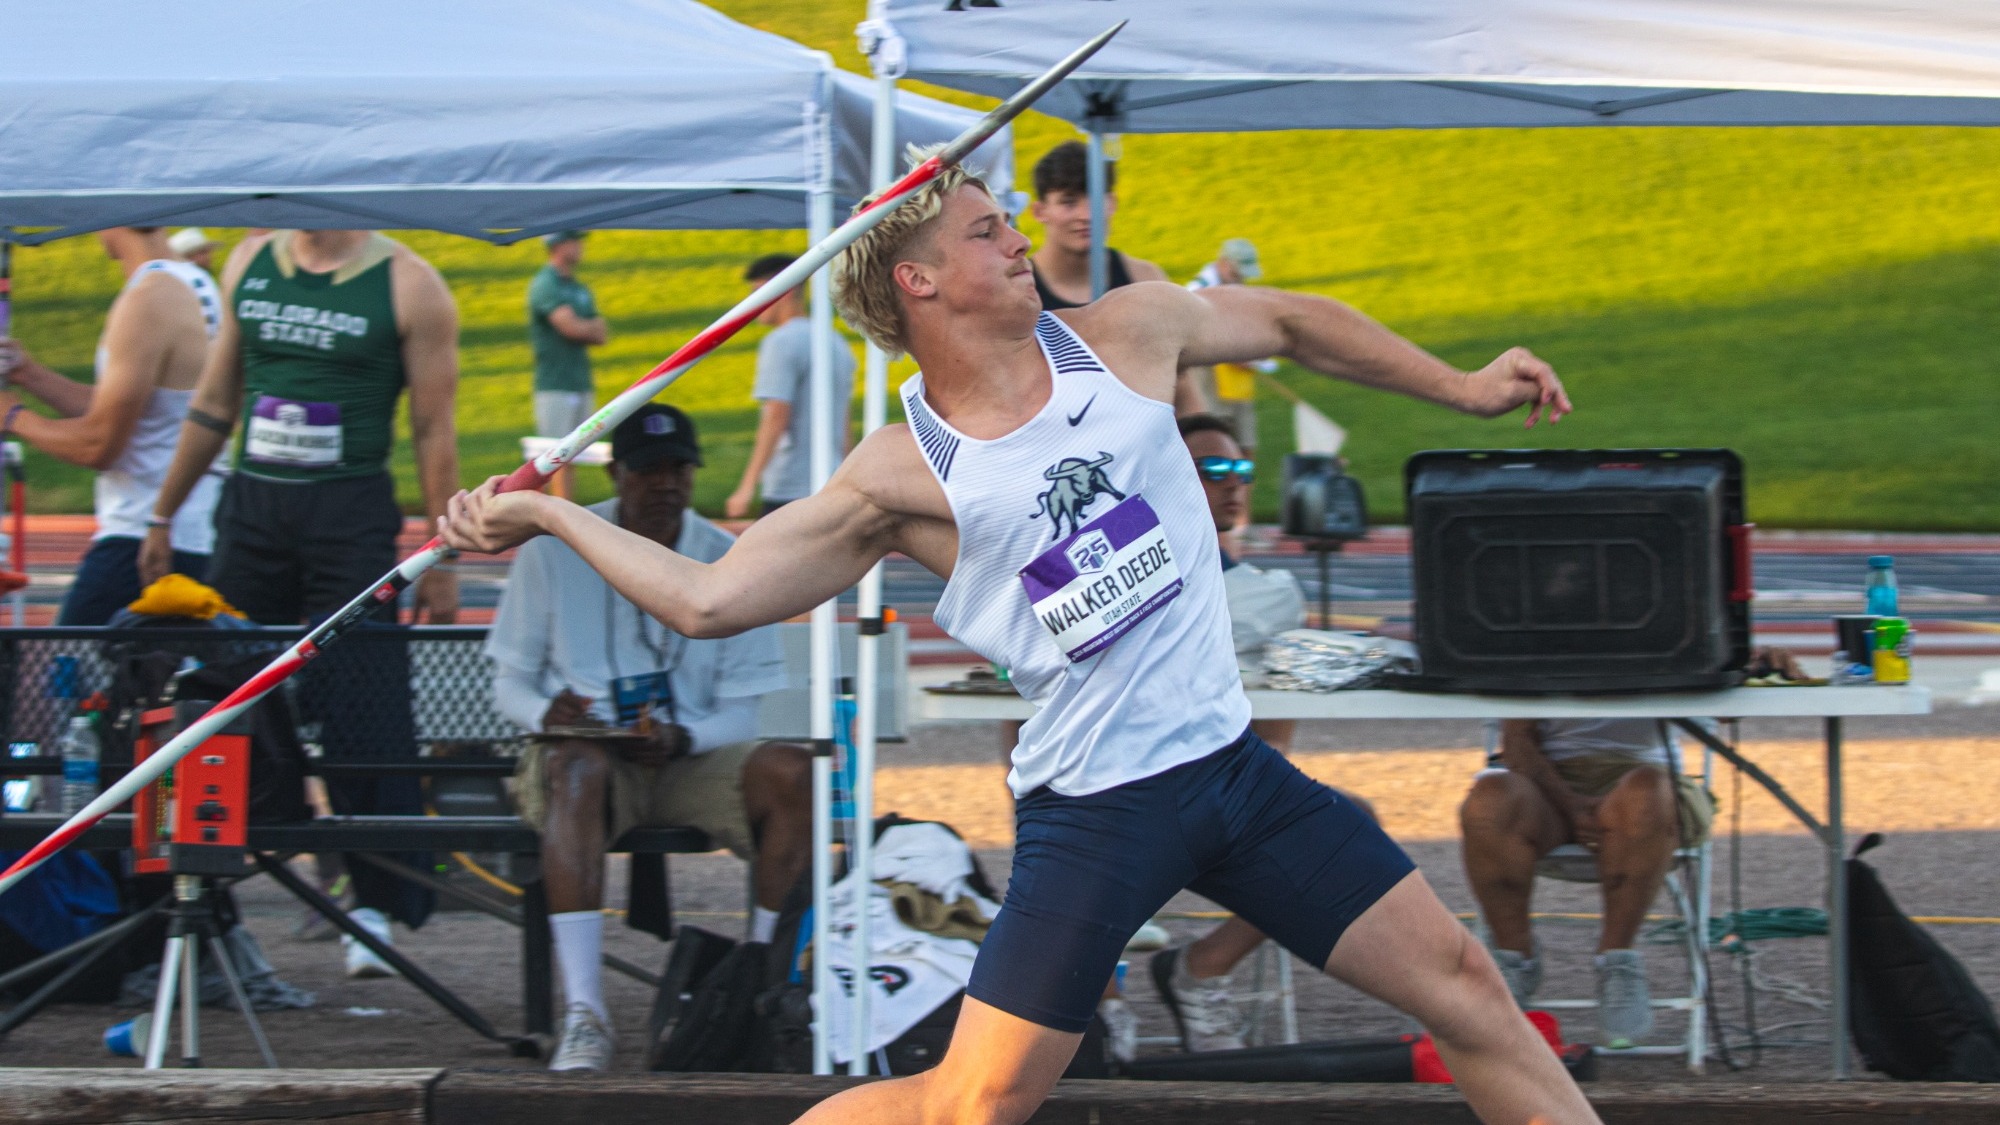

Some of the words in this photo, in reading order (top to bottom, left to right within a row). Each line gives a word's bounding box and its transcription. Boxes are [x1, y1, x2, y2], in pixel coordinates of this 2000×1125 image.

[238, 299, 369, 337] COLORADO
[259, 320, 336, 350] STATE
[1073, 537, 1109, 570] 25
[1041, 574, 1122, 636] WALKER
[1117, 538, 1171, 590] DEEDE
[1102, 606, 1123, 625] UTAH
[1120, 592, 1142, 614] STATE
